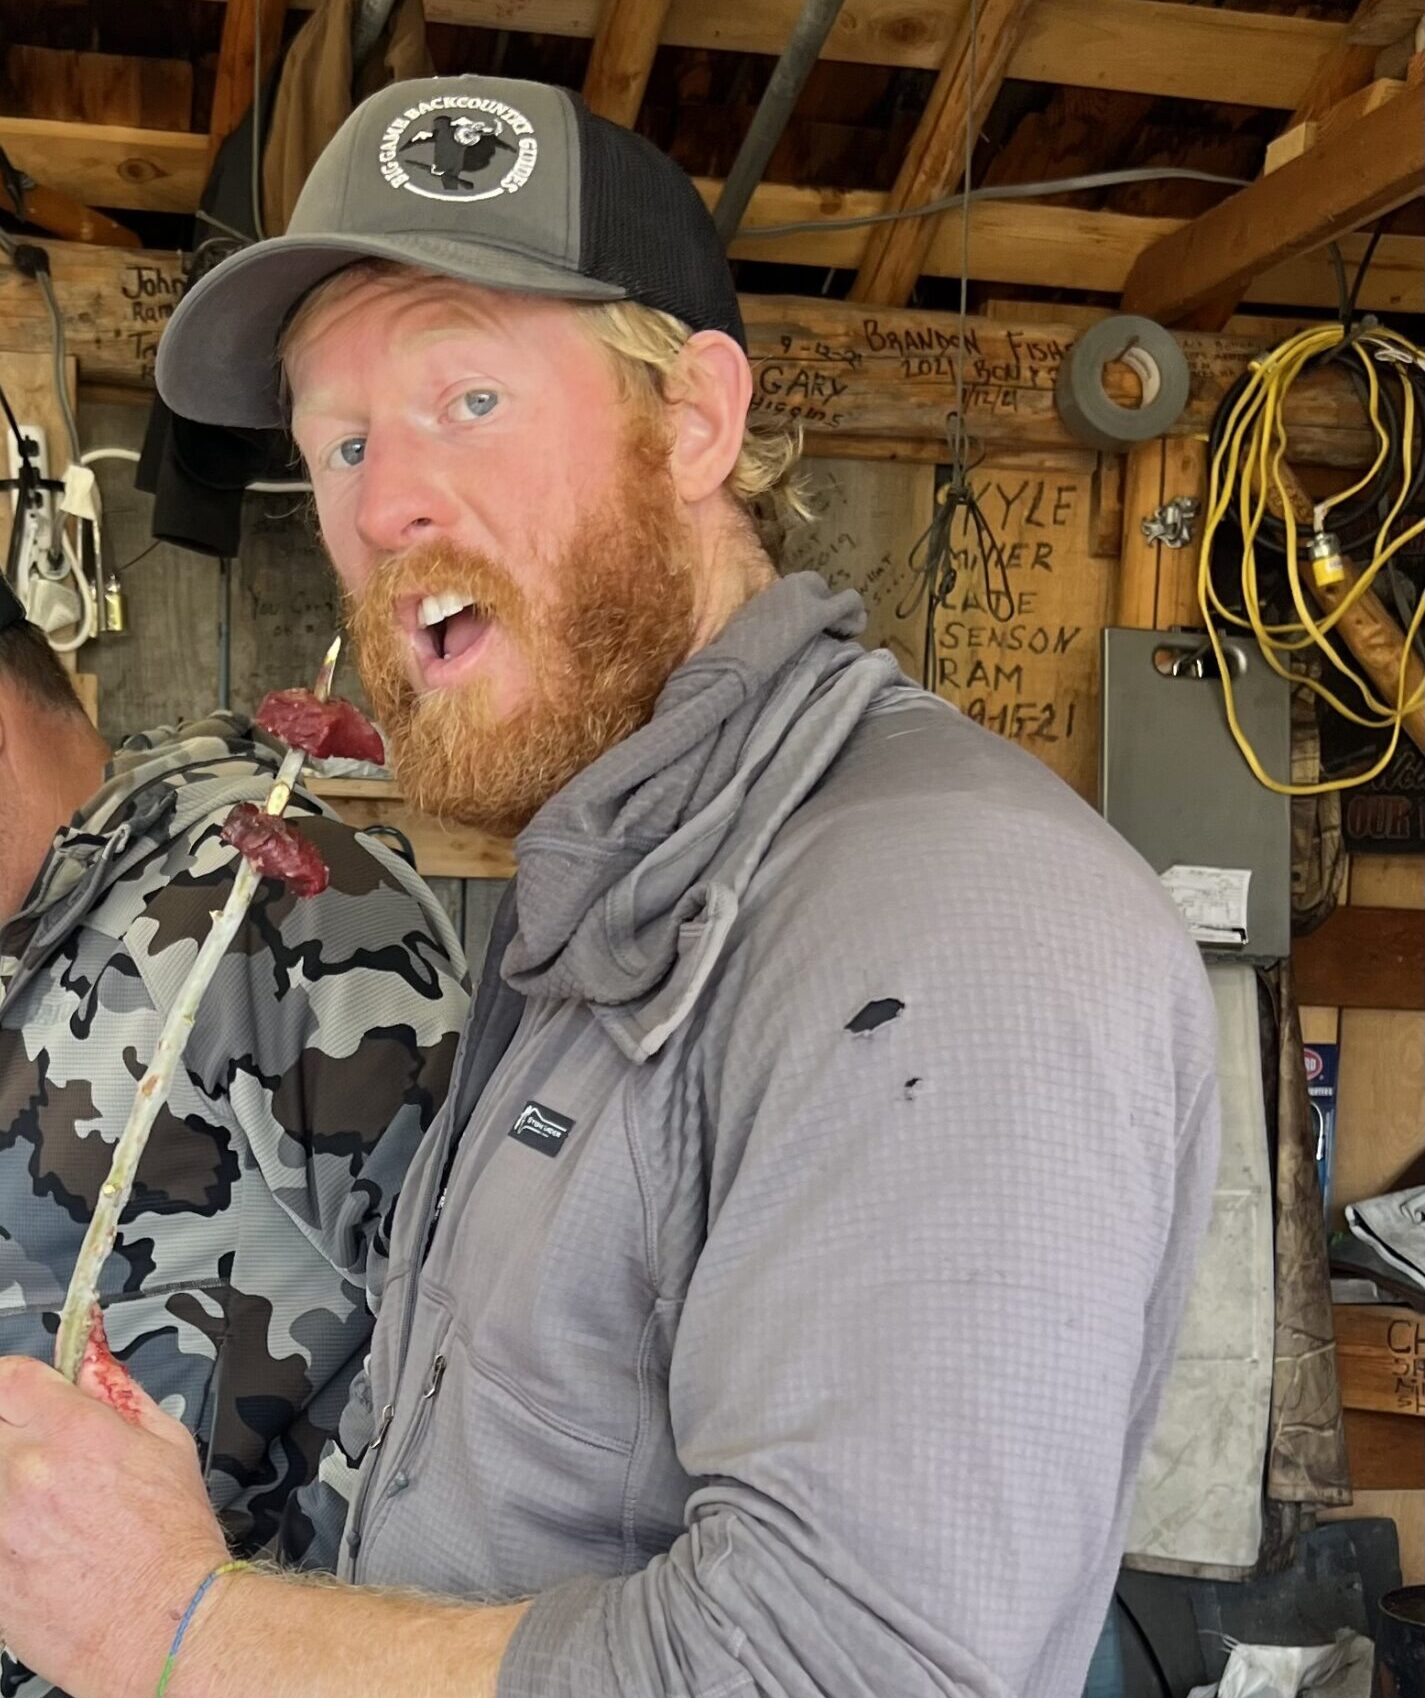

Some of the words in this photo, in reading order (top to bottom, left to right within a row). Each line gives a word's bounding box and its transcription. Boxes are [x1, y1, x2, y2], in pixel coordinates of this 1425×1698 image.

[403, 96, 535, 135] BACKCOUNTRY
[500, 137, 538, 194] GUIDES
[863, 319, 981, 358] BRANDON
[760, 366, 848, 406] GARY
[962, 481, 1077, 536] KYLE
[940, 589, 1037, 616] LATE
[939, 657, 1023, 694] RAM
